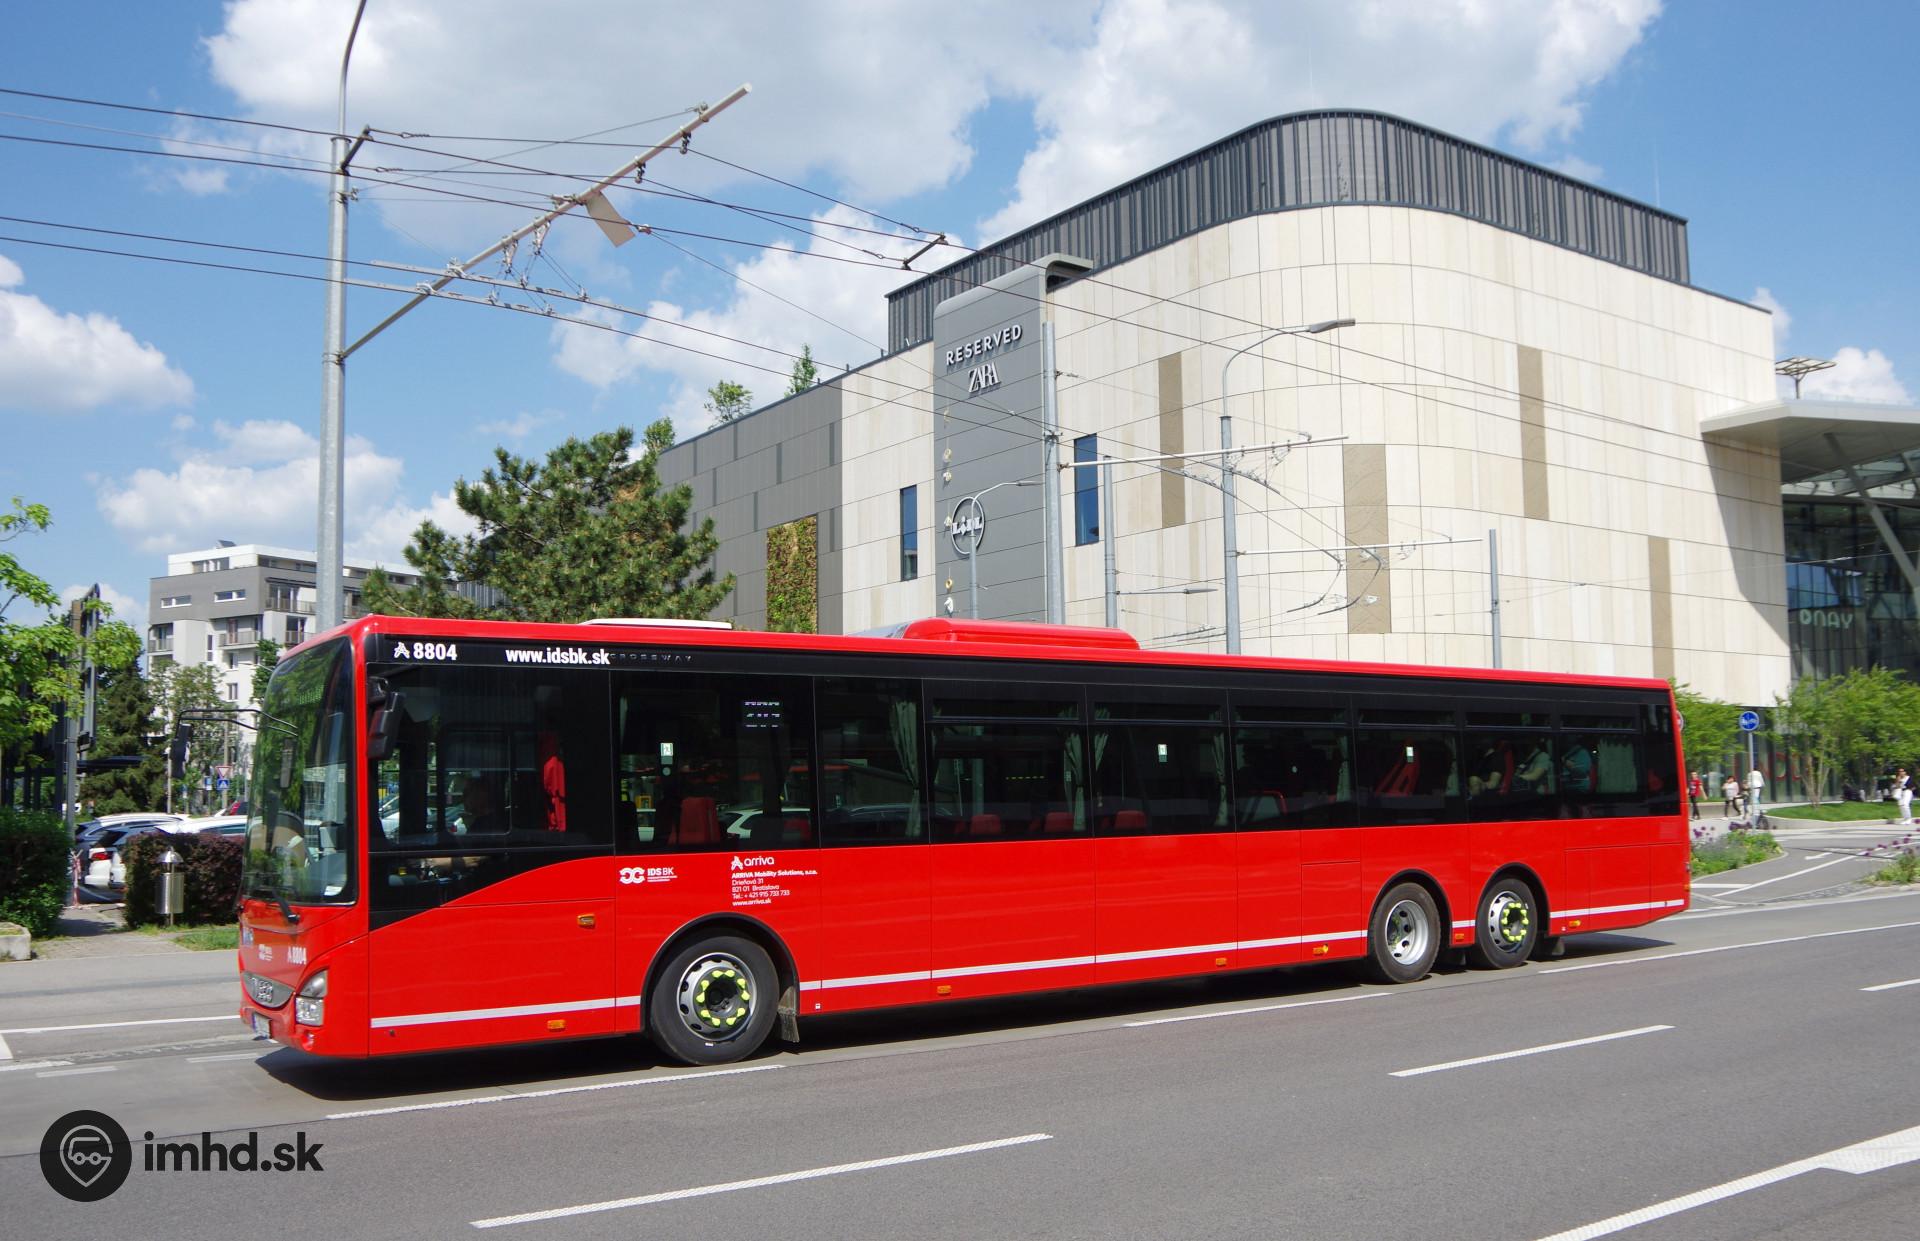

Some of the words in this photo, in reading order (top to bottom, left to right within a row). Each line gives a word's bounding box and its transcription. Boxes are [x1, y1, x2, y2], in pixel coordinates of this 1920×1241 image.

[946, 324, 1021, 366] RESERVED
[968, 362, 1000, 393] ZARA
[413, 642, 458, 661] 8804
[506, 647, 611, 665] www.idsbk.sk
[744, 856, 774, 866] arriva
[754, 870, 776, 878] Mobility
[732, 898, 772, 906] www.arriva.sk
